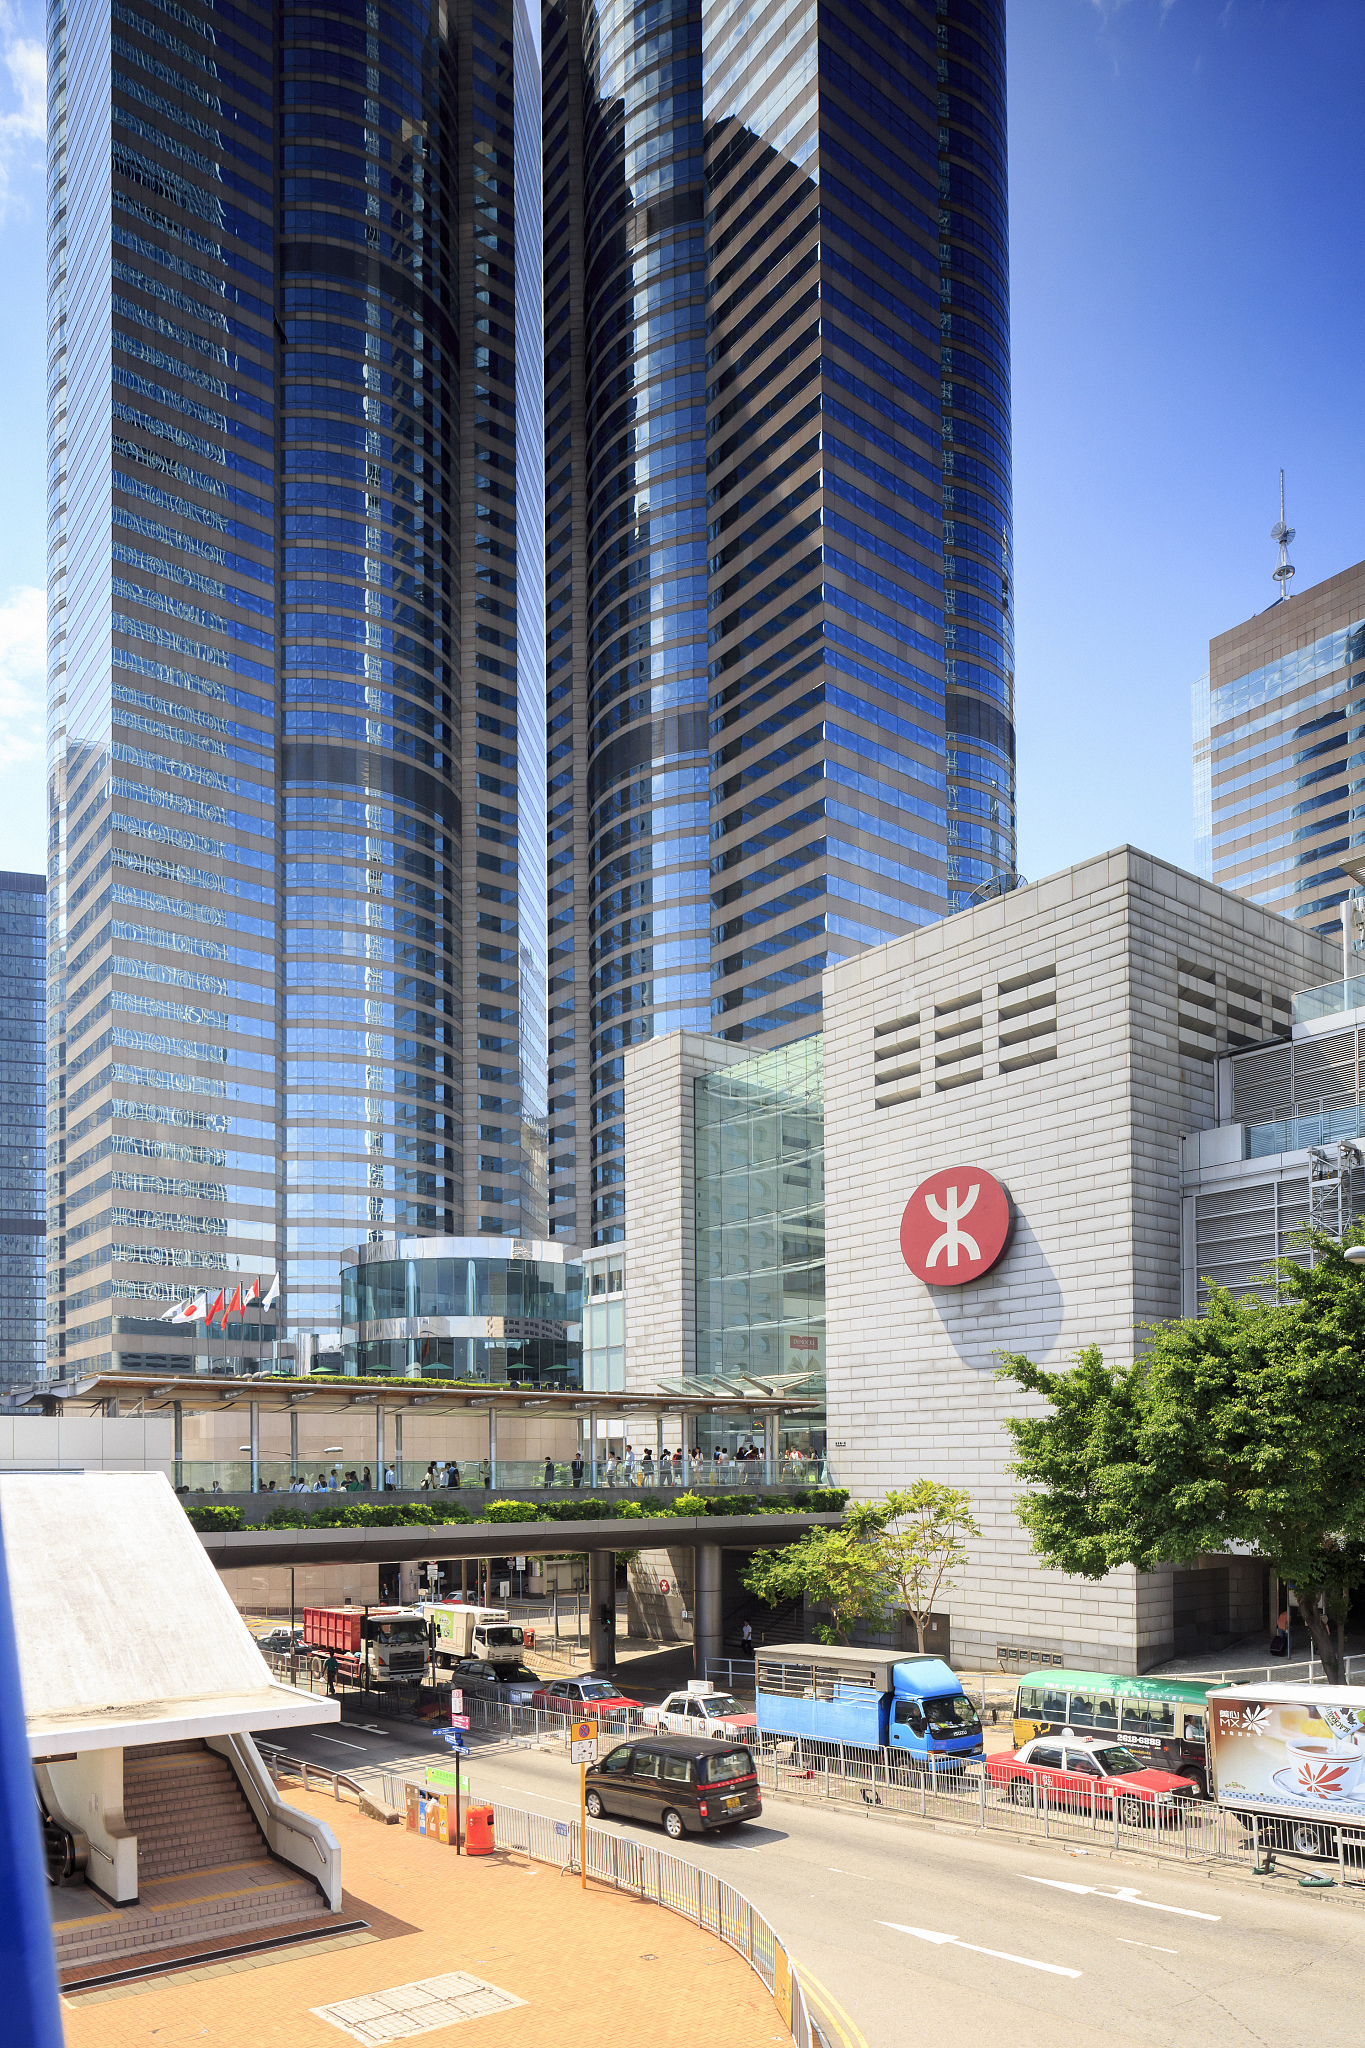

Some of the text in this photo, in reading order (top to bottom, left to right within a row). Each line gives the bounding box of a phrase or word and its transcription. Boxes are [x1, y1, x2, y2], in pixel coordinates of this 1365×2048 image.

[1219, 1709, 1240, 1720] 美心
[1219, 1718, 1240, 1728] MX
[587, 1740, 593, 1749] 7
[1116, 1733, 1162, 1747] 2618-6888
[587, 1752, 593, 1760] 7
